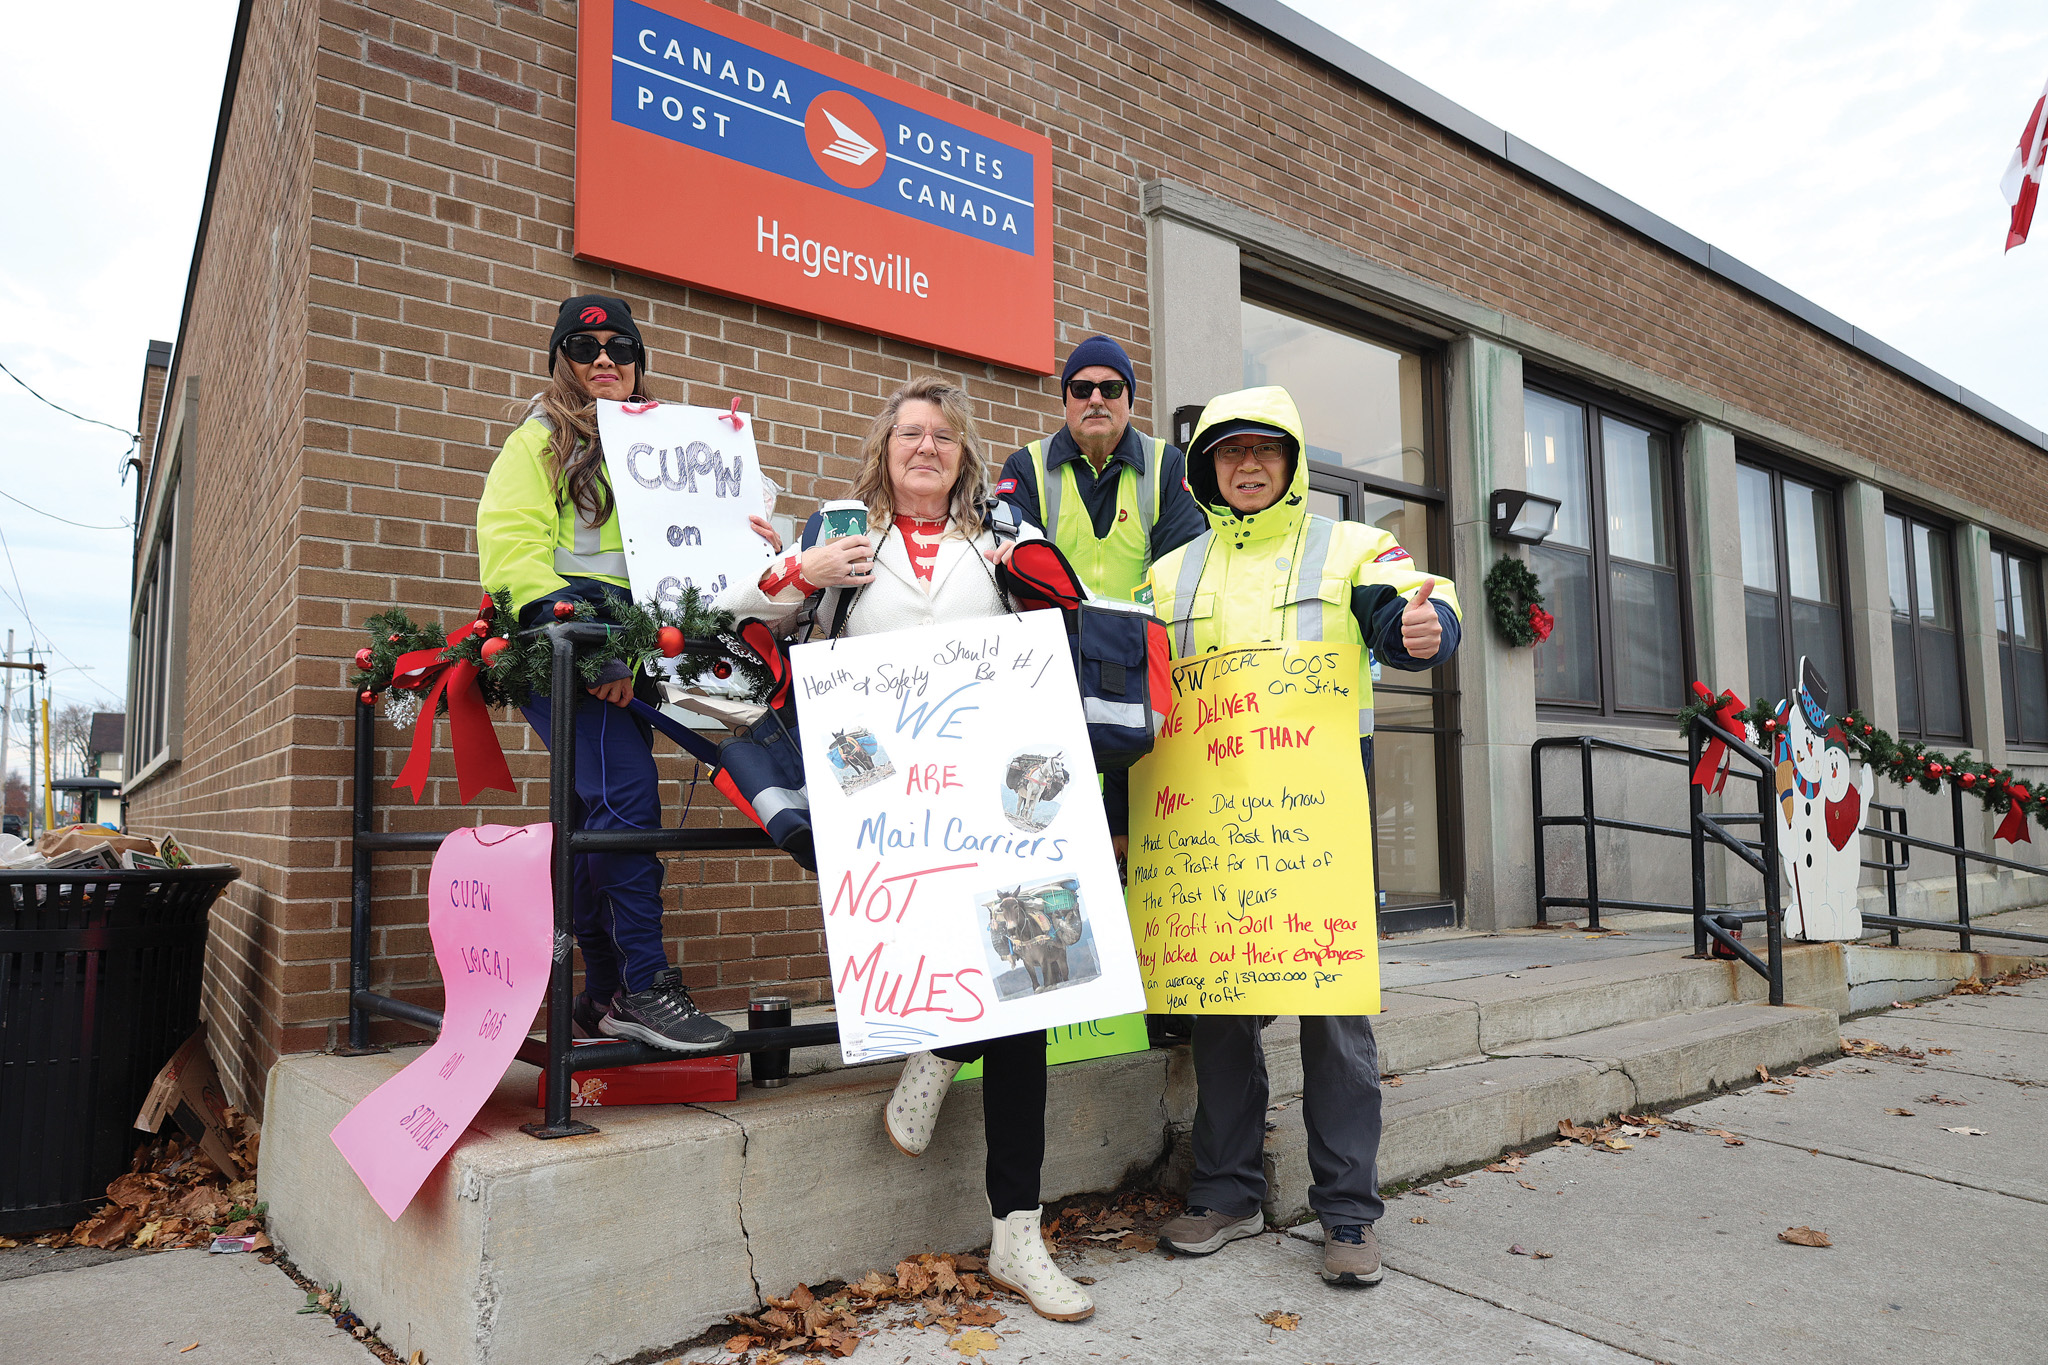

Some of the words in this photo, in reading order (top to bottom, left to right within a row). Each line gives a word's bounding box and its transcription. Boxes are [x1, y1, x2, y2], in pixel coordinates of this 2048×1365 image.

[637, 28, 792, 105] CANADA
[637, 86, 730, 138] POST
[898, 124, 1003, 181] POSTES
[898, 177, 1018, 235] CANADA
[756, 215, 929, 299] Hagersville
[627, 441, 743, 498] CUPW
[667, 525, 702, 547] on
[803, 669, 854, 700] Health
[875, 663, 929, 699] Safety
[933, 635, 1000, 665] Should
[975, 662, 996, 681] Be
[1213, 653, 1260, 681] LOCAL
[1283, 648, 1339, 675] 605
[1304, 675, 1350, 698] Strike
[895, 682, 980, 740] WE
[1207, 736, 1244, 766] MORE
[1250, 726, 1315, 750] THAN
[906, 763, 964, 795] ARE
[1209, 794, 1235, 814] Did
[1238, 795, 1274, 822] you
[857, 809, 930, 856] Mail
[944, 817, 1069, 862] Carriers
[1141, 833, 1164, 853] that
[1168, 830, 1220, 849] Canada
[1222, 823, 1264, 846] Post
[1272, 824, 1309, 844] has
[1165, 864, 1176, 876] a
[1174, 852, 1219, 874] Profit
[1227, 853, 1245, 873] for
[1256, 855, 1269, 871] 17
[1313, 851, 1333, 871] of
[451, 879, 491, 912] CUPW
[1142, 892, 1163, 911] the
[1169, 882, 1202, 905] Past
[1213, 884, 1227, 901] 18
[1227, 886, 1277, 921] years
[1166, 912, 1207, 938] Profit
[1214, 920, 1233, 934] in
[1283, 912, 1314, 933] the
[1314, 917, 1358, 947] year
[461, 946, 513, 988] LOCAL
[1163, 942, 1198, 966] locked
[1210, 945, 1236, 963] out
[1242, 942, 1288, 966] their
[1147, 980, 1159, 989] an
[1166, 975, 1205, 990] average
[1215, 970, 1229, 984] of
[1313, 971, 1343, 988] per
[439, 1052, 465, 1080] ON
[400, 1104, 449, 1151] STRIKE
